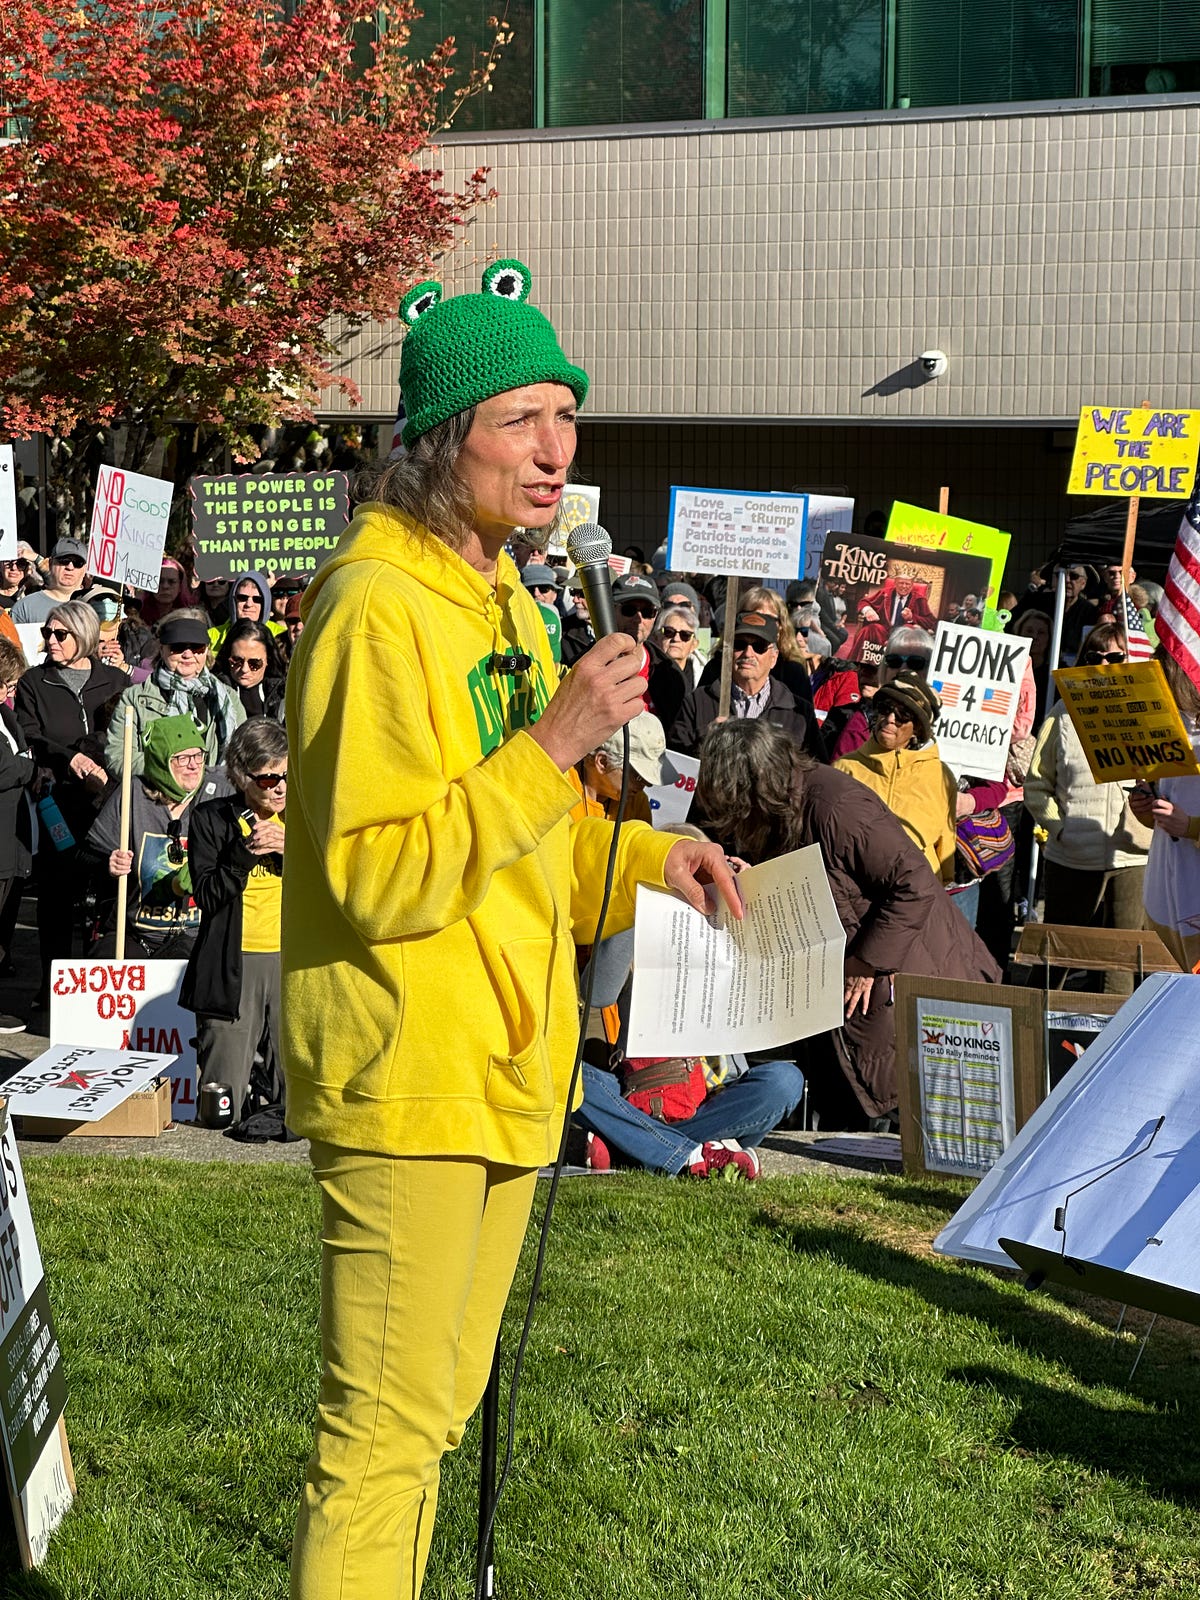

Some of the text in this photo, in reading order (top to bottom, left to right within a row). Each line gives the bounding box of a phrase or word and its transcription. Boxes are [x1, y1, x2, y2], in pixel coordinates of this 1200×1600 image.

[1092, 409, 1190, 438] WE ARE
[1114, 439, 1152, 459] THE
[97, 469, 125, 506] NO
[203, 478, 335, 496] THE POWER OF
[1085, 463, 1189, 493] PEOPLE
[203, 497, 336, 515] THE PEOPLE IS
[694, 496, 724, 509] Love
[744, 501, 799, 514] Condemn
[92, 503, 120, 538] NO
[678, 506, 732, 521] America
[752, 513, 795, 528] tRump
[216, 518, 326, 534] STRONGER
[199, 539, 245, 553] THAN
[248, 537, 280, 552] THE
[685, 528, 787, 547] Patriots uphold the
[88, 536, 116, 577] NO
[683, 542, 763, 558] Constitution
[766, 550, 781, 560] not
[835, 543, 888, 568] KING
[230, 557, 316, 572] IN POWER
[696, 556, 770, 574] Fascist King
[824, 560, 888, 585] TRUMP
[934, 630, 1025, 684] HONK
[1123, 675, 1135, 684] TO
[962, 685, 977, 712] 4
[1070, 692, 1084, 701] BUY
[1077, 706, 1099, 715] TRUMP
[1152, 702, 1162, 710] TO
[933, 718, 1009, 746] MOCRACY
[1089, 734, 1099, 743] DO
[1103, 733, 1116, 741] YOU
[1120, 732, 1134, 741] SEE
[1138, 731, 1146, 740] IT
[1094, 741, 1186, 768] NO KINGS
[53, 965, 145, 995] BACK?
[97, 993, 136, 1020] GO
[120, 1028, 183, 1054] WHY
[945, 1035, 1000, 1051] NO KINGS
[51, 1048, 96, 1071] FACTS
[923, 1046, 999, 1061] Top 10 Rally Reminders
[18, 1072, 62, 1094] OVER
